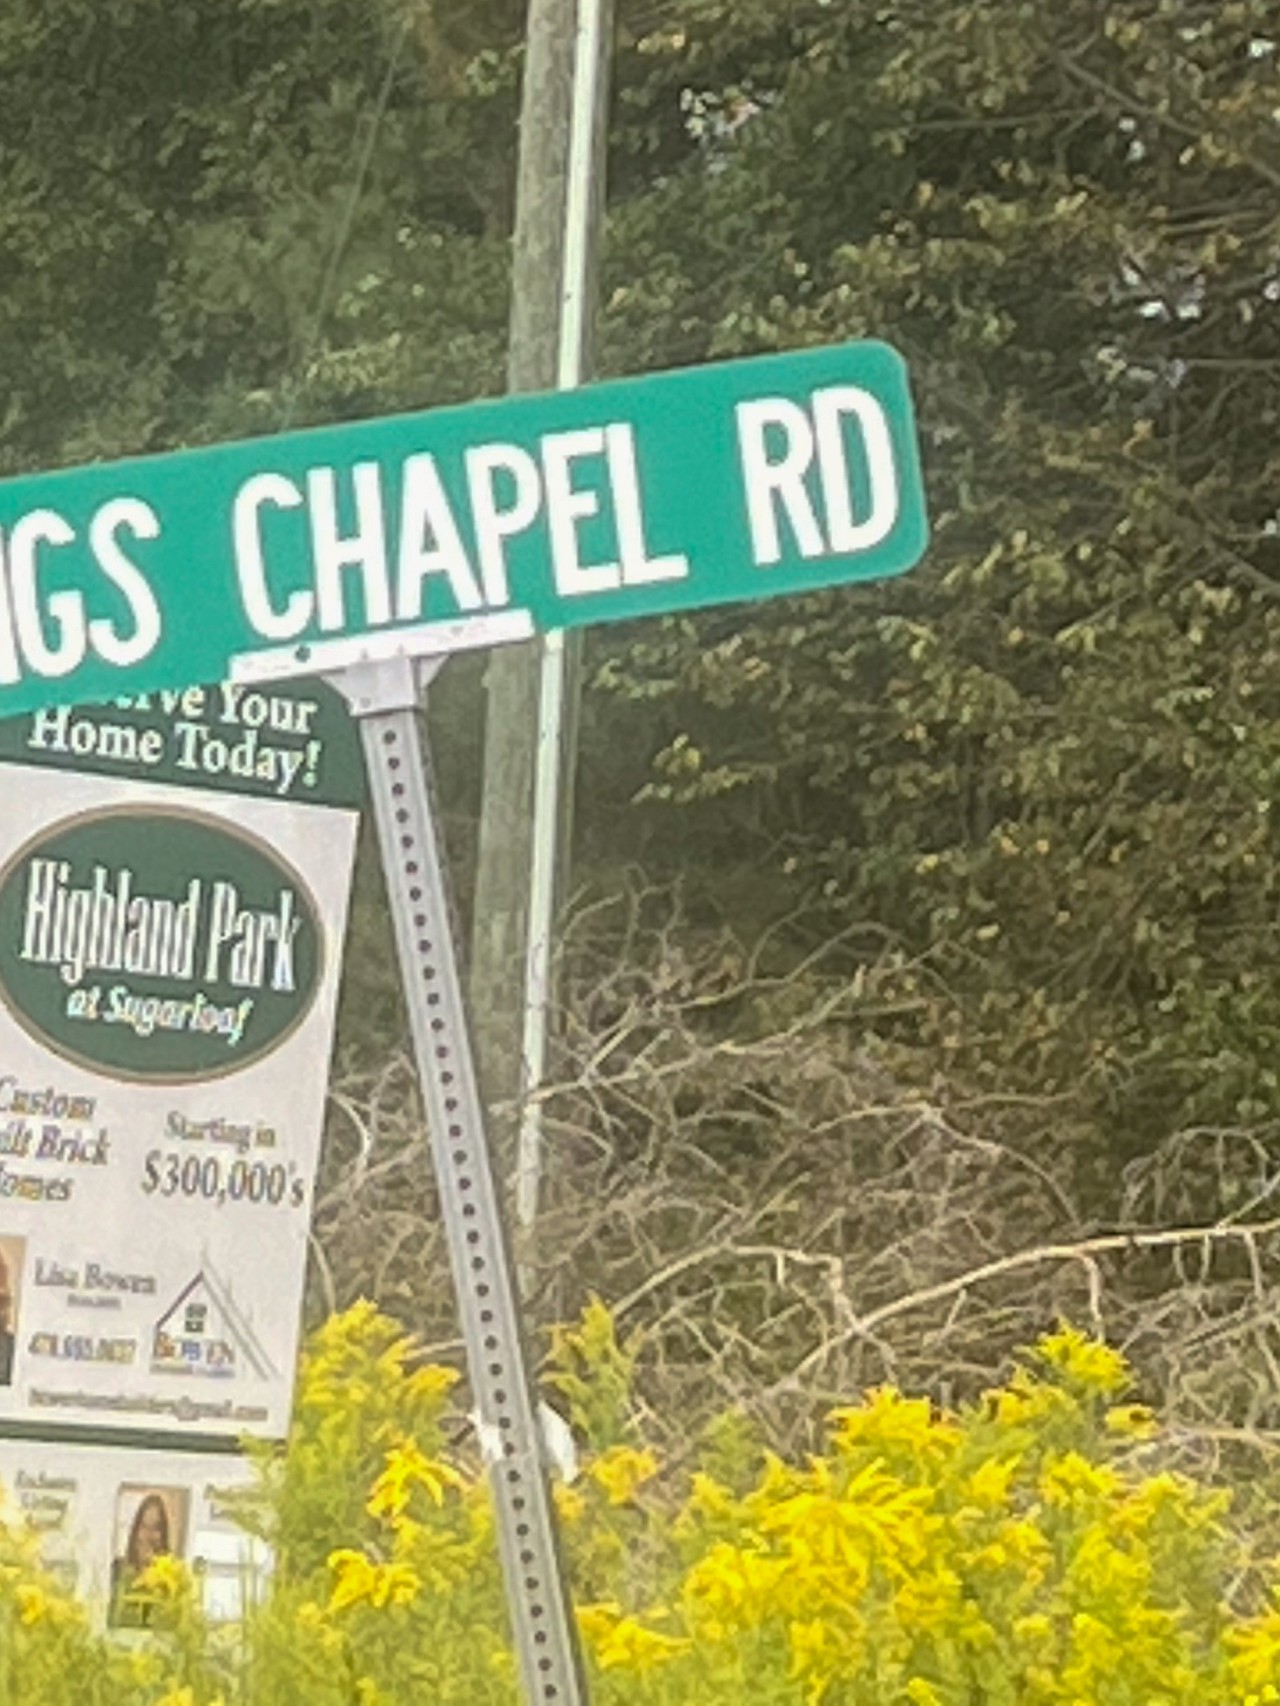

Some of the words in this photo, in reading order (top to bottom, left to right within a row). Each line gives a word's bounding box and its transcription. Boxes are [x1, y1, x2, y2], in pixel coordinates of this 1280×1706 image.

[232, 422, 689, 640] CHAPEL
[734, 386, 899, 565] RD
[220, 679, 318, 733] Your
[27, 704, 163, 763] Home
[174, 722, 322, 794] Today!
[20, 858, 203, 987] Highland
[204, 882, 303, 991] Park
[67, 986, 101, 1019] at
[103, 986, 254, 1047] Sugarloaf
[35, 1124, 111, 1165] Brick
[141, 1149, 305, 1207] $300,000's
